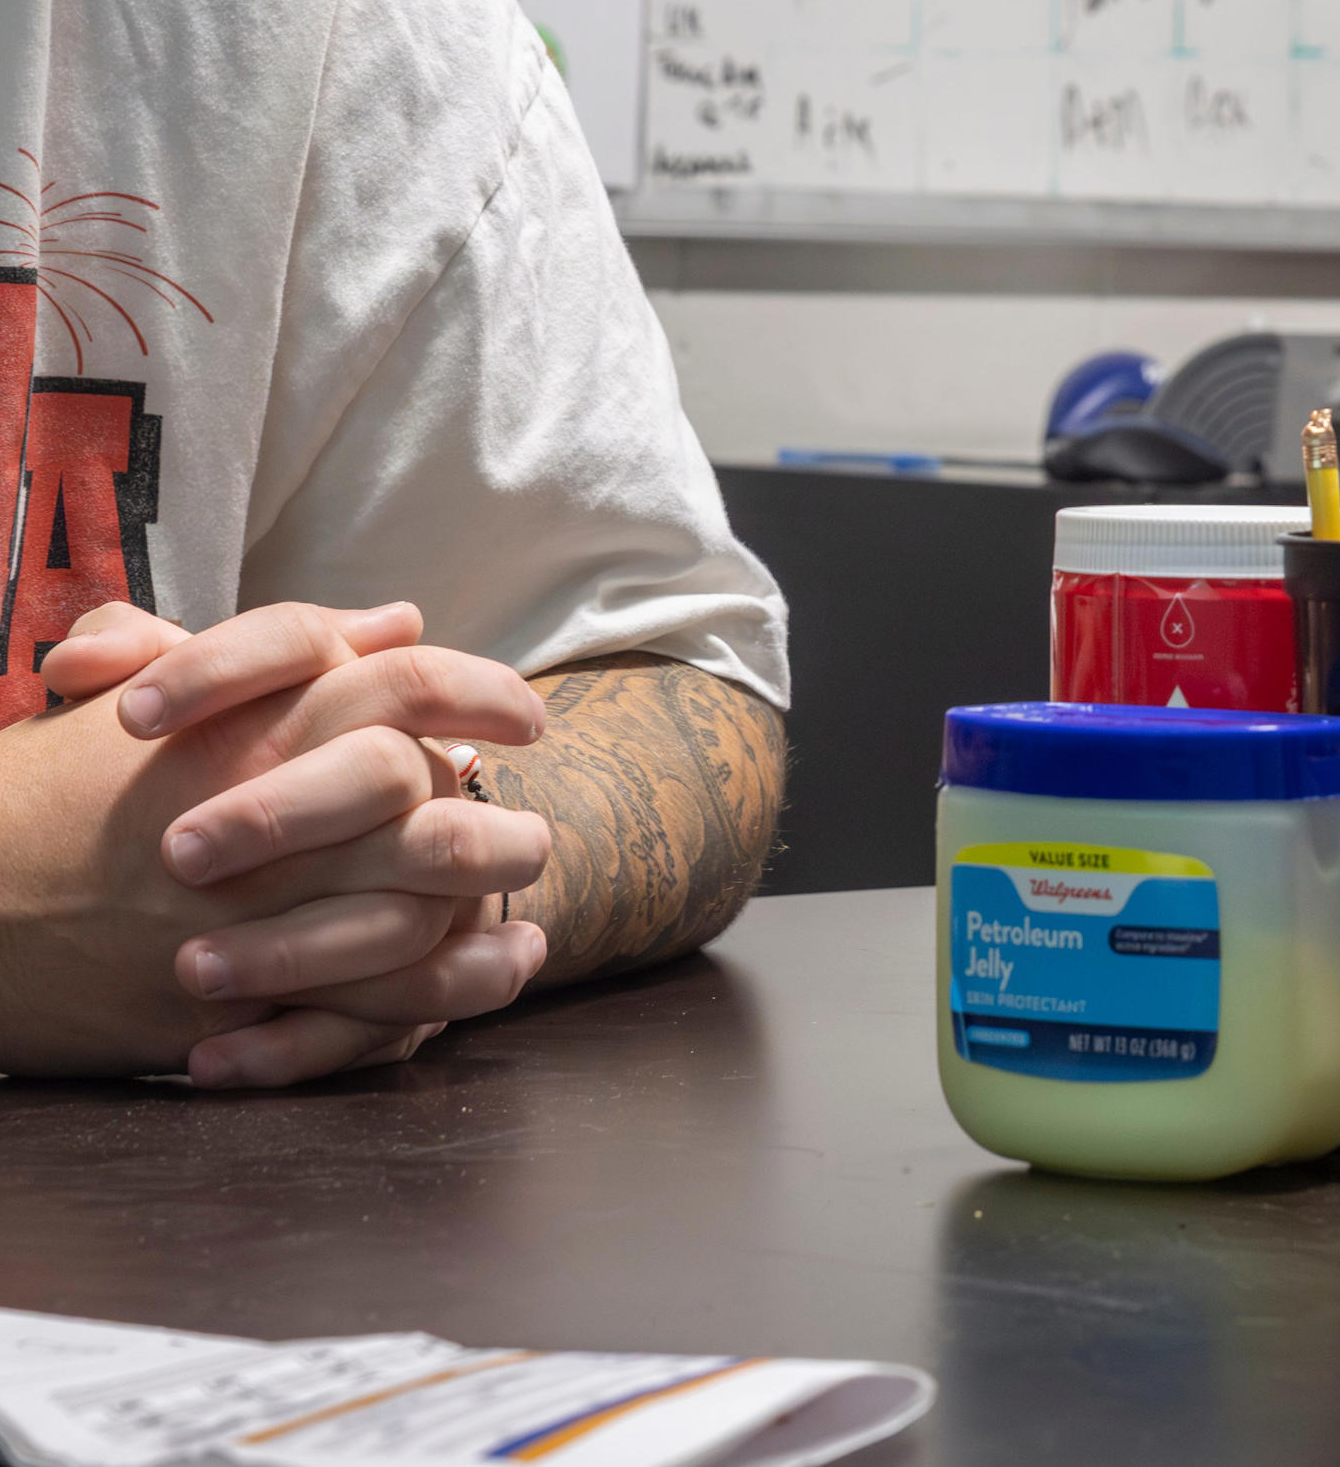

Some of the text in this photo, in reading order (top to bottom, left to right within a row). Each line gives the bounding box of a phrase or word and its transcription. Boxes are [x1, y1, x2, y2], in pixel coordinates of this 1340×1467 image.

[1029, 849, 1111, 869] VALUE SIZE
[1029, 878, 1114, 905] Walgreens
[966, 909, 1084, 951] Petroleum
[964, 945, 1014, 992] Jelly
[966, 990, 1088, 1014] SKIN PROTECTANT
[1067, 1033, 1091, 1053] NET
[1093, 1034, 1113, 1053] WT
